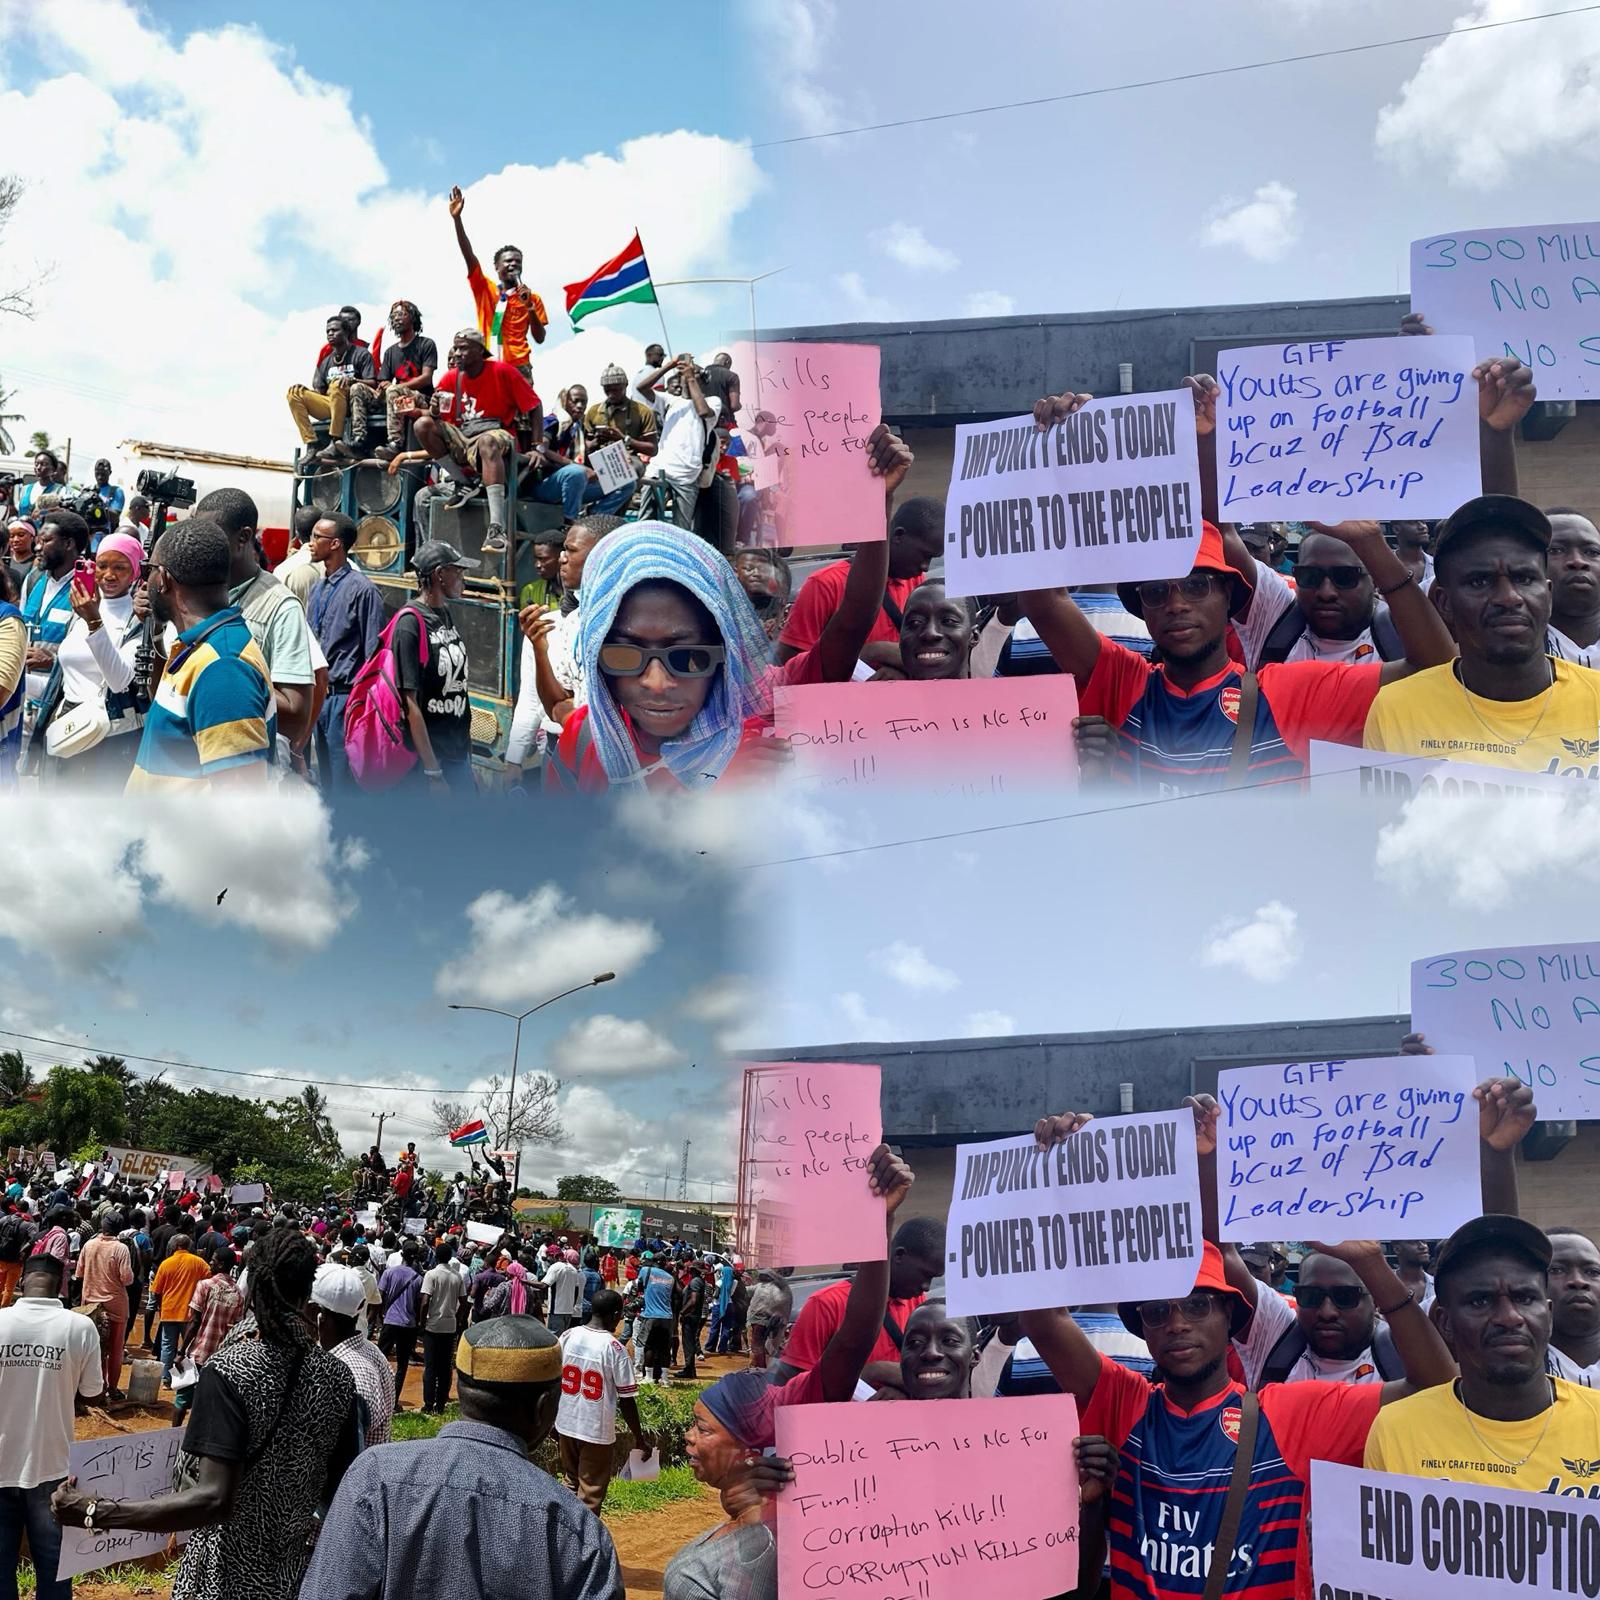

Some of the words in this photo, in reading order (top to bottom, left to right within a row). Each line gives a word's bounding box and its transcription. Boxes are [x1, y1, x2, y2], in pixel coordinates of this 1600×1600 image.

[1425, 239, 1525, 267] 300
[1283, 341, 1346, 365] GFF
[1335, 373, 1387, 398] are
[1396, 367, 1465, 403] giving
[960, 423, 1052, 480] IMPUNITY
[1056, 408, 1108, 466] ENDS
[1111, 402, 1176, 460] TODAY
[1228, 414, 1256, 438] up
[1270, 411, 1293, 429] on
[1320, 423, 1348, 457] of
[1362, 418, 1444, 461] Bad
[960, 497, 1036, 559] POWER
[1037, 494, 1067, 550] TO
[1068, 490, 1108, 547] THE
[1110, 482, 1193, 544] PEOPLE!
[1421, 739, 1446, 749] FINELY
[1448, 741, 1485, 752] CRAFTED
[1487, 743, 1517, 755] GOODS
[1426, 959, 1526, 987] 300
[1284, 1061, 1347, 1085] GFF
[1336, 1093, 1388, 1118] are
[1397, 1087, 1466, 1123] giving
[961, 1143, 1053, 1200] IMPUNITY
[1057, 1128, 1109, 1186] ENDS
[1112, 1122, 1177, 1180] TODAY
[1229, 1134, 1257, 1158] up
[1271, 1131, 1294, 1149] on
[1321, 1143, 1349, 1177] of
[1363, 1138, 1445, 1181] Bad
[961, 1217, 1037, 1279] POWER
[1038, 1214, 1068, 1270] TO
[1069, 1210, 1109, 1267] THE
[1111, 1202, 1194, 1264] PEOPLE!
[560, 1364, 604, 1402] 99
[1421, 1459, 1447, 1469] FINELY
[1448, 1460, 1485, 1472] CRAFTED
[1487, 1463, 1517, 1475] GOODS
[1158, 1501, 1200, 1537] Fly
[1360, 1485, 1414, 1566] END
[1421, 1493, 1600, 1598] CORRUPTIO
